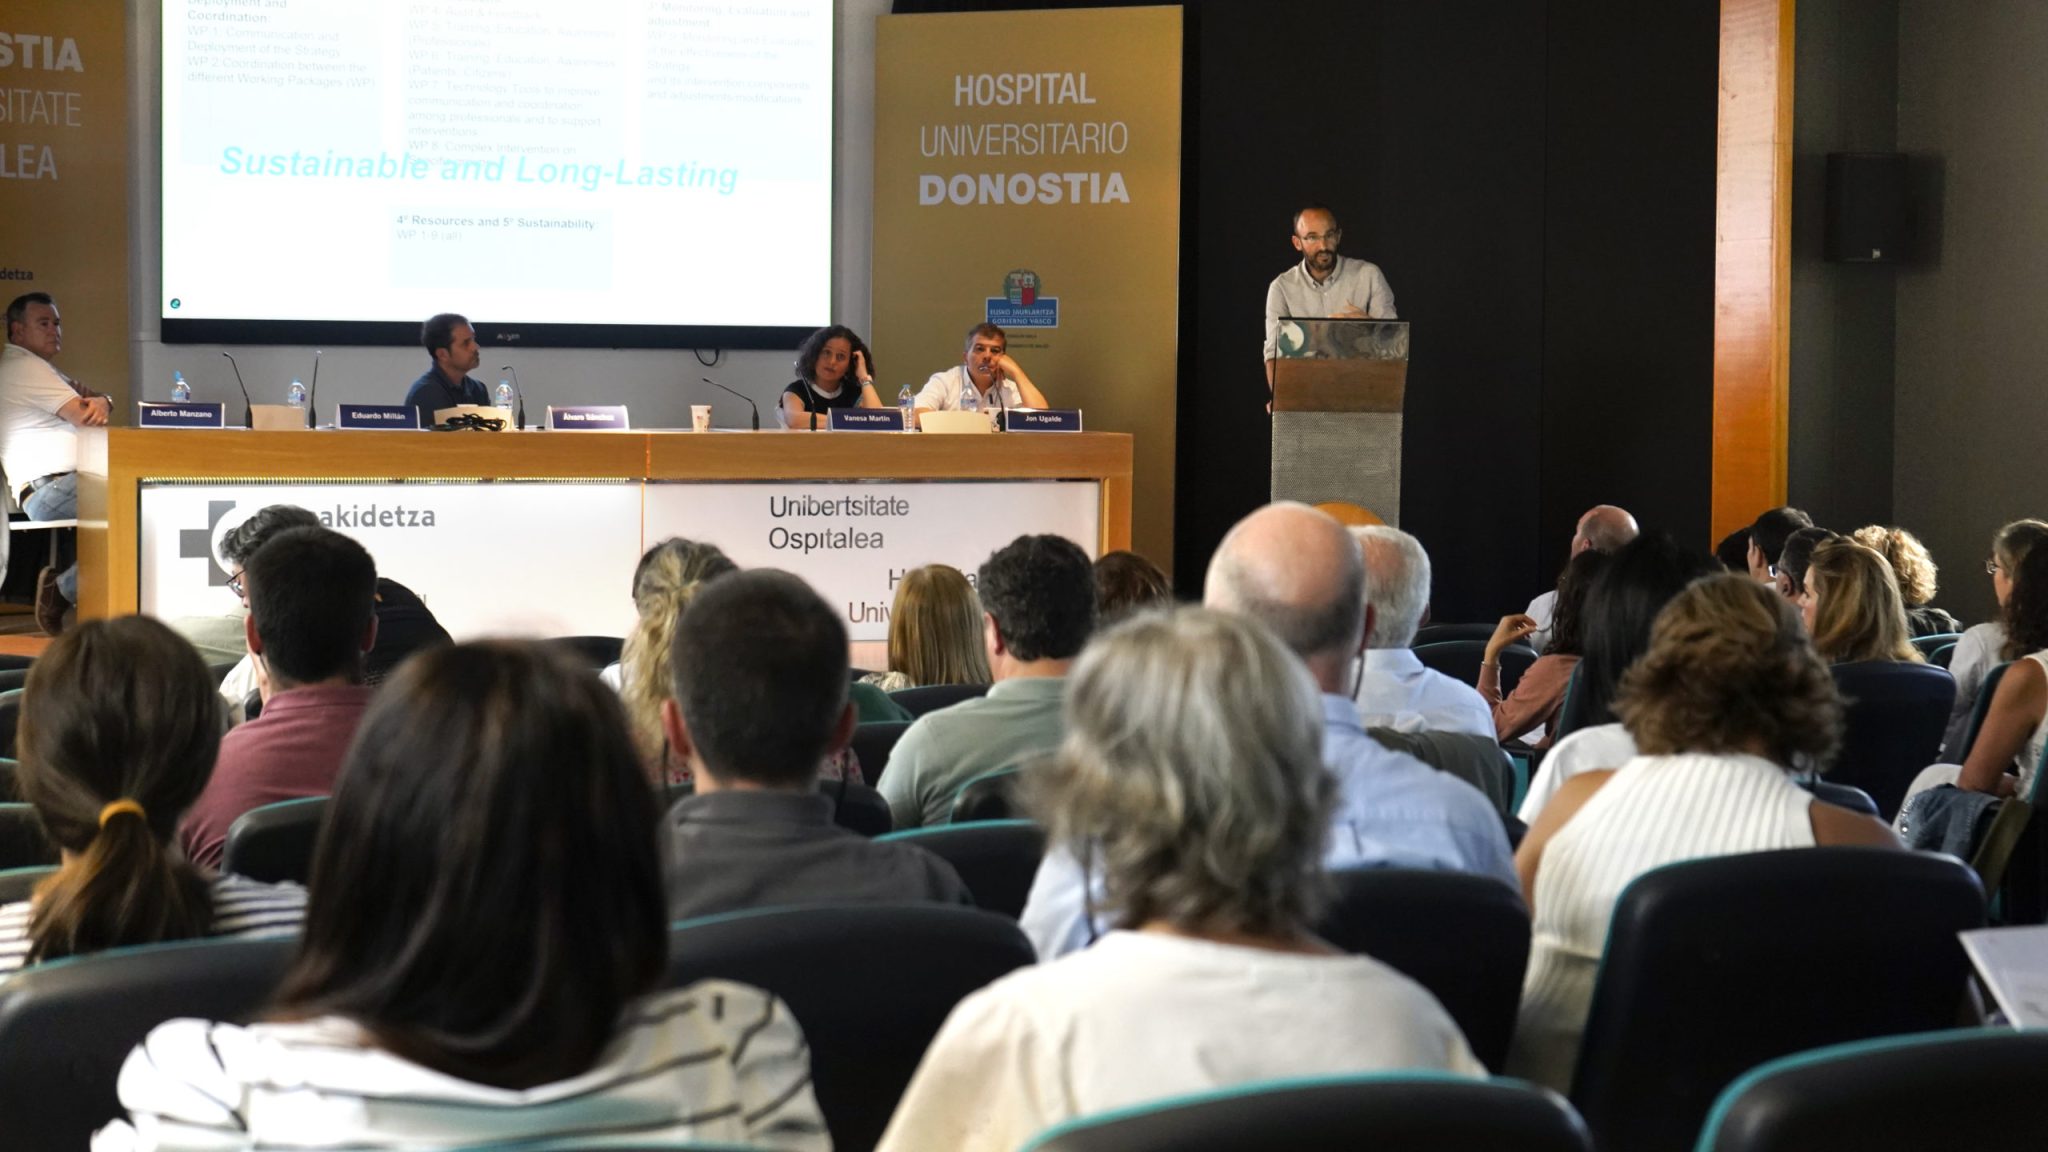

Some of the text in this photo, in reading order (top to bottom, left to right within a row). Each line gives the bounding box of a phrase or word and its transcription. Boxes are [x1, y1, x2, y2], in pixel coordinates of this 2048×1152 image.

[187, 9, 271, 24] Coordination:
[187, 57, 209, 67] WP
[222, 57, 295, 70] Coordination
[237, 74, 284, 87] Working
[287, 75, 343, 89] Packages
[954, 72, 1097, 107] HOSPITAL
[408, 96, 491, 107] communication
[920, 121, 1129, 157] UNIVERSITARIO
[220, 146, 738, 195] Sustainable and Long-Lasting
[919, 172, 1131, 206] DONOSTIA
[411, 215, 474, 227] Resources
[477, 217, 500, 228] and
[990, 308, 1055, 316] EUSKO JAURLARITZA
[150, 409, 213, 418] Alberto Manzano
[351, 411, 382, 419] Eduardo
[843, 414, 868, 422] Vanesa
[1039, 415, 1063, 424] Ugalde
[770, 494, 910, 518] Unibertsitate
[320, 504, 436, 528] akidetza
[768, 526, 884, 554] Ospitalea
